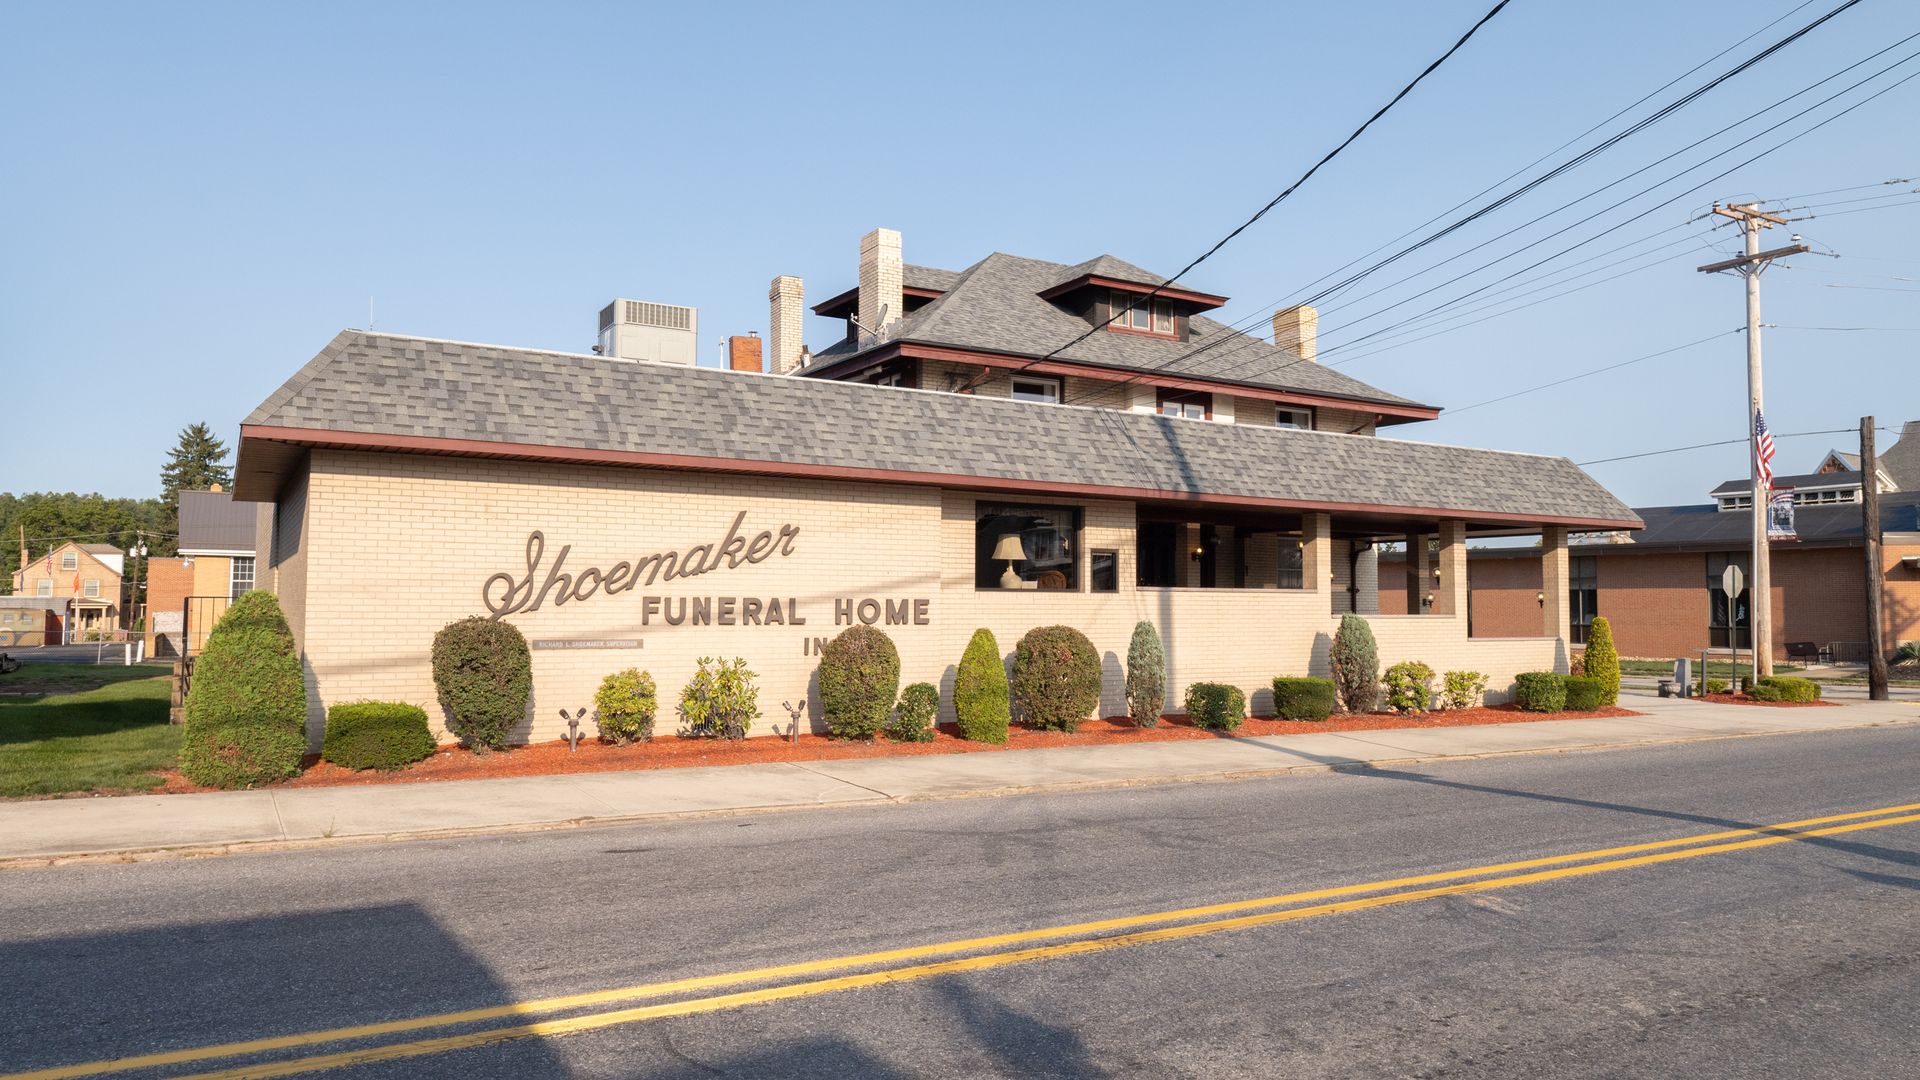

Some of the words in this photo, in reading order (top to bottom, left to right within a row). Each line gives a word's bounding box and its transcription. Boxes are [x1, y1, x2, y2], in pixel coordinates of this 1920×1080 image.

[483, 510, 800, 621] Shoemaker
[642, 596, 806, 625] FUNERAL
[834, 598, 930, 625] HOME
[804, 637, 828, 656] IN
